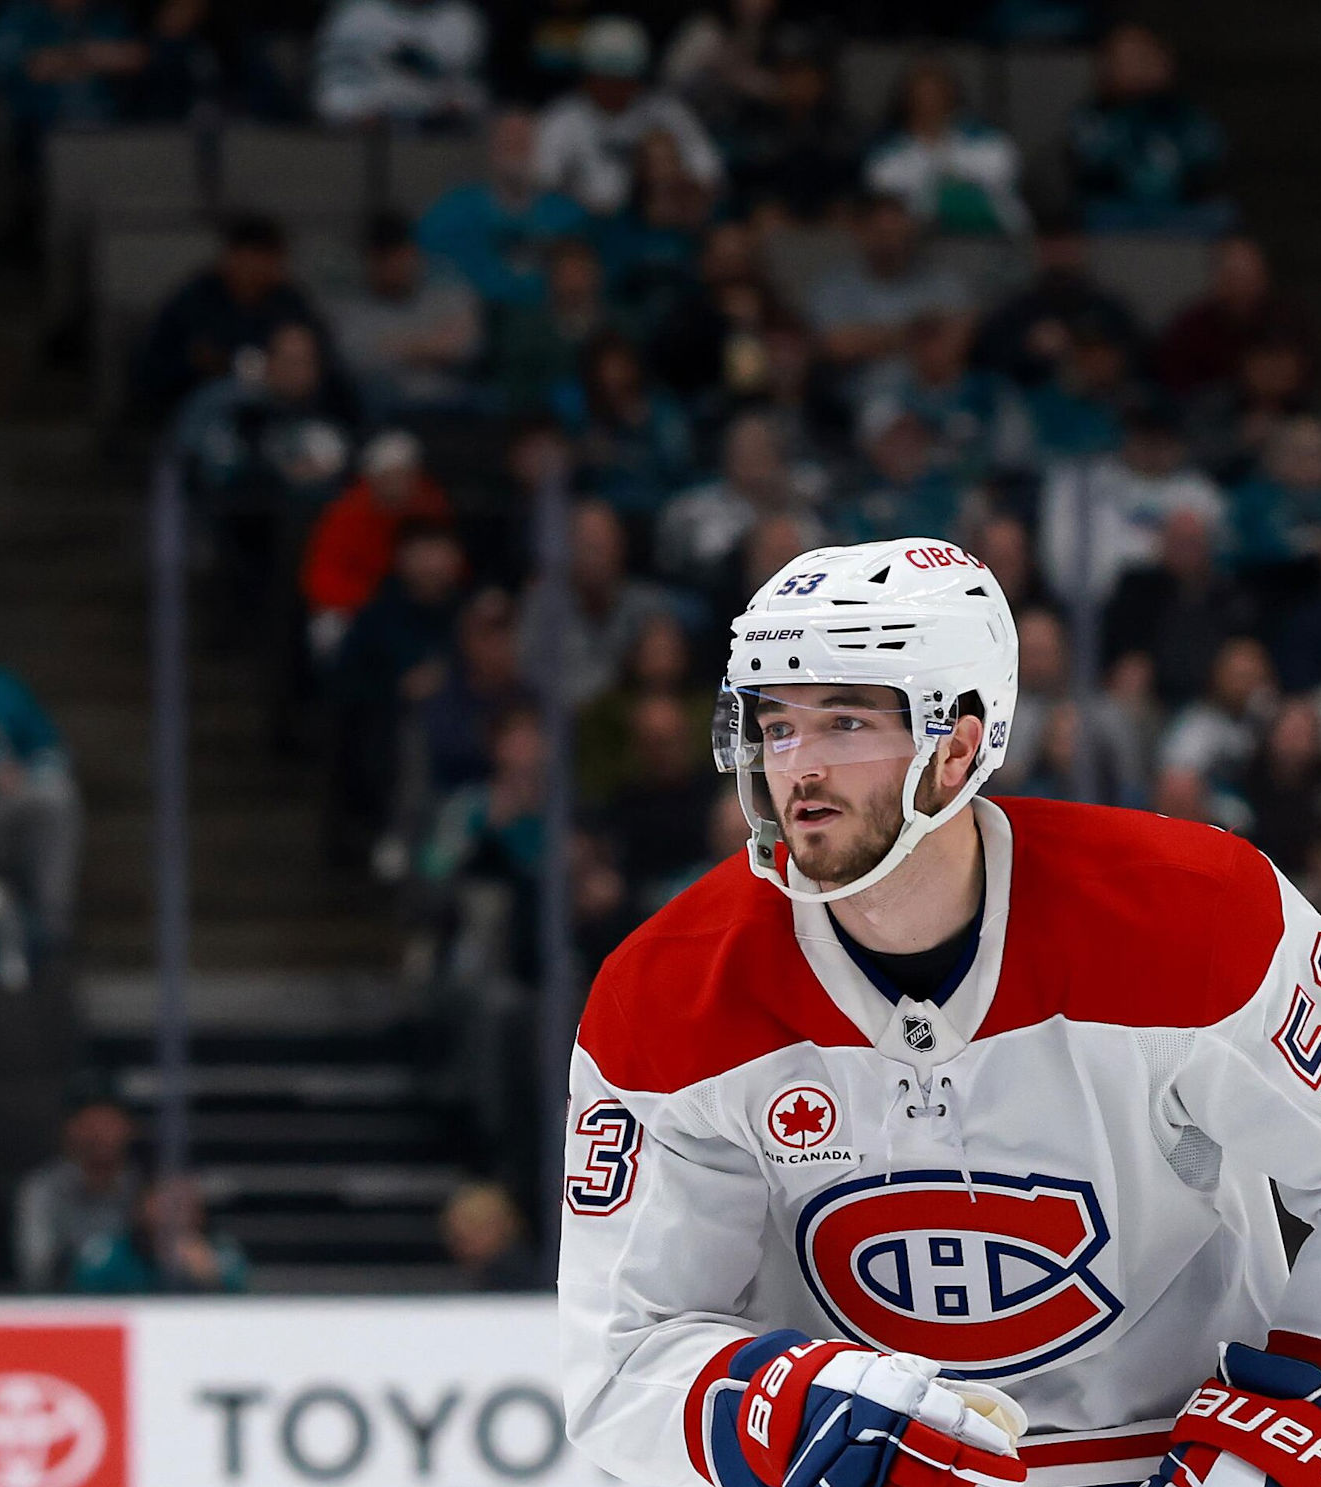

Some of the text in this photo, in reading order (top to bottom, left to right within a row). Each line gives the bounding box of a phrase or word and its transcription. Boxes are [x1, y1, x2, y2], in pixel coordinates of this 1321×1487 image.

[904, 547, 969, 570] CIBC
[776, 573, 829, 596] 53
[744, 629, 805, 642] BAUER
[909, 1025, 929, 1045] NHL
[562, 1098, 645, 1217] 3
[788, 1150, 852, 1164] CANADA
[195, 1383, 620, 1486] TOYO
